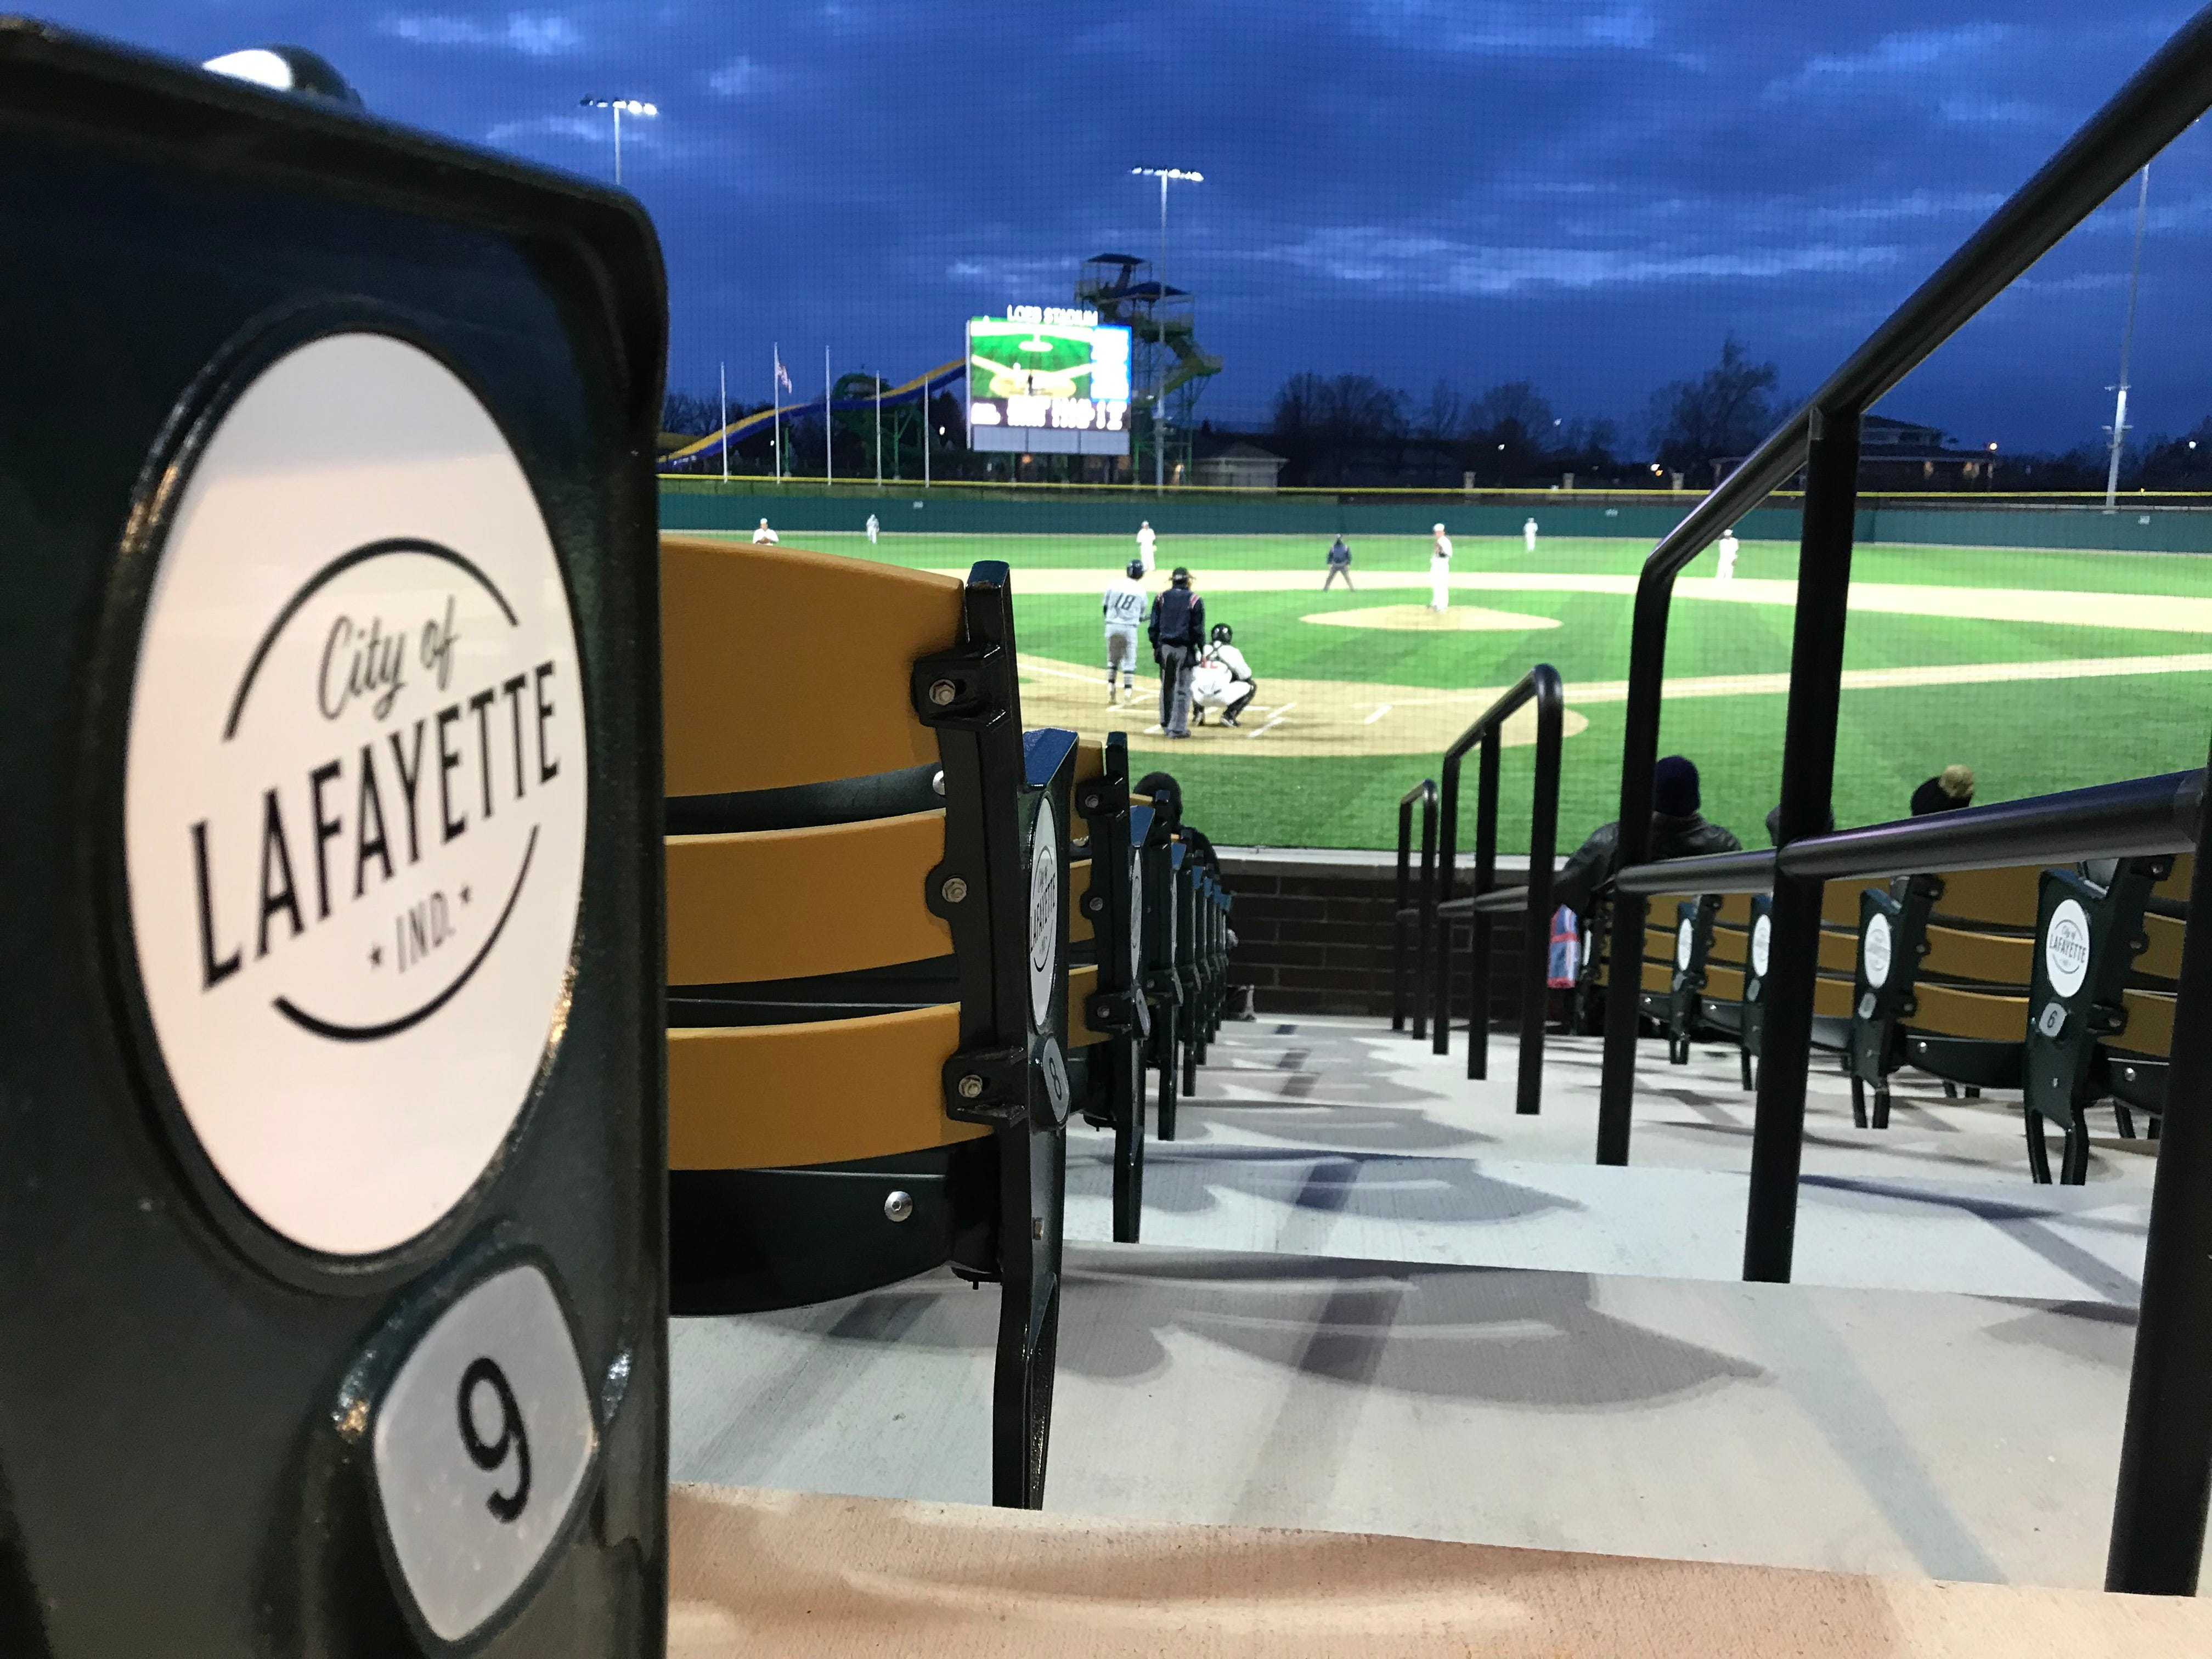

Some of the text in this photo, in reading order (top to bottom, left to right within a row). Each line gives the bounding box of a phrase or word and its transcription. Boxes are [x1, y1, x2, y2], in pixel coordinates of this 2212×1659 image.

[1043, 307, 1098, 325] STADIUM
[1115, 592, 1136, 611] 18
[317, 594, 461, 721] City of
[189, 660, 561, 992] LAFAYETTE
[396, 890, 456, 974] IND.
[1030, 872, 1056, 953] LAFAYETTE
[2049, 934, 2086, 963] LAFAYETTE
[2047, 1010, 2057, 1029] 6
[1049, 1057, 1062, 1101] 8
[457, 1356, 532, 1523] 9
